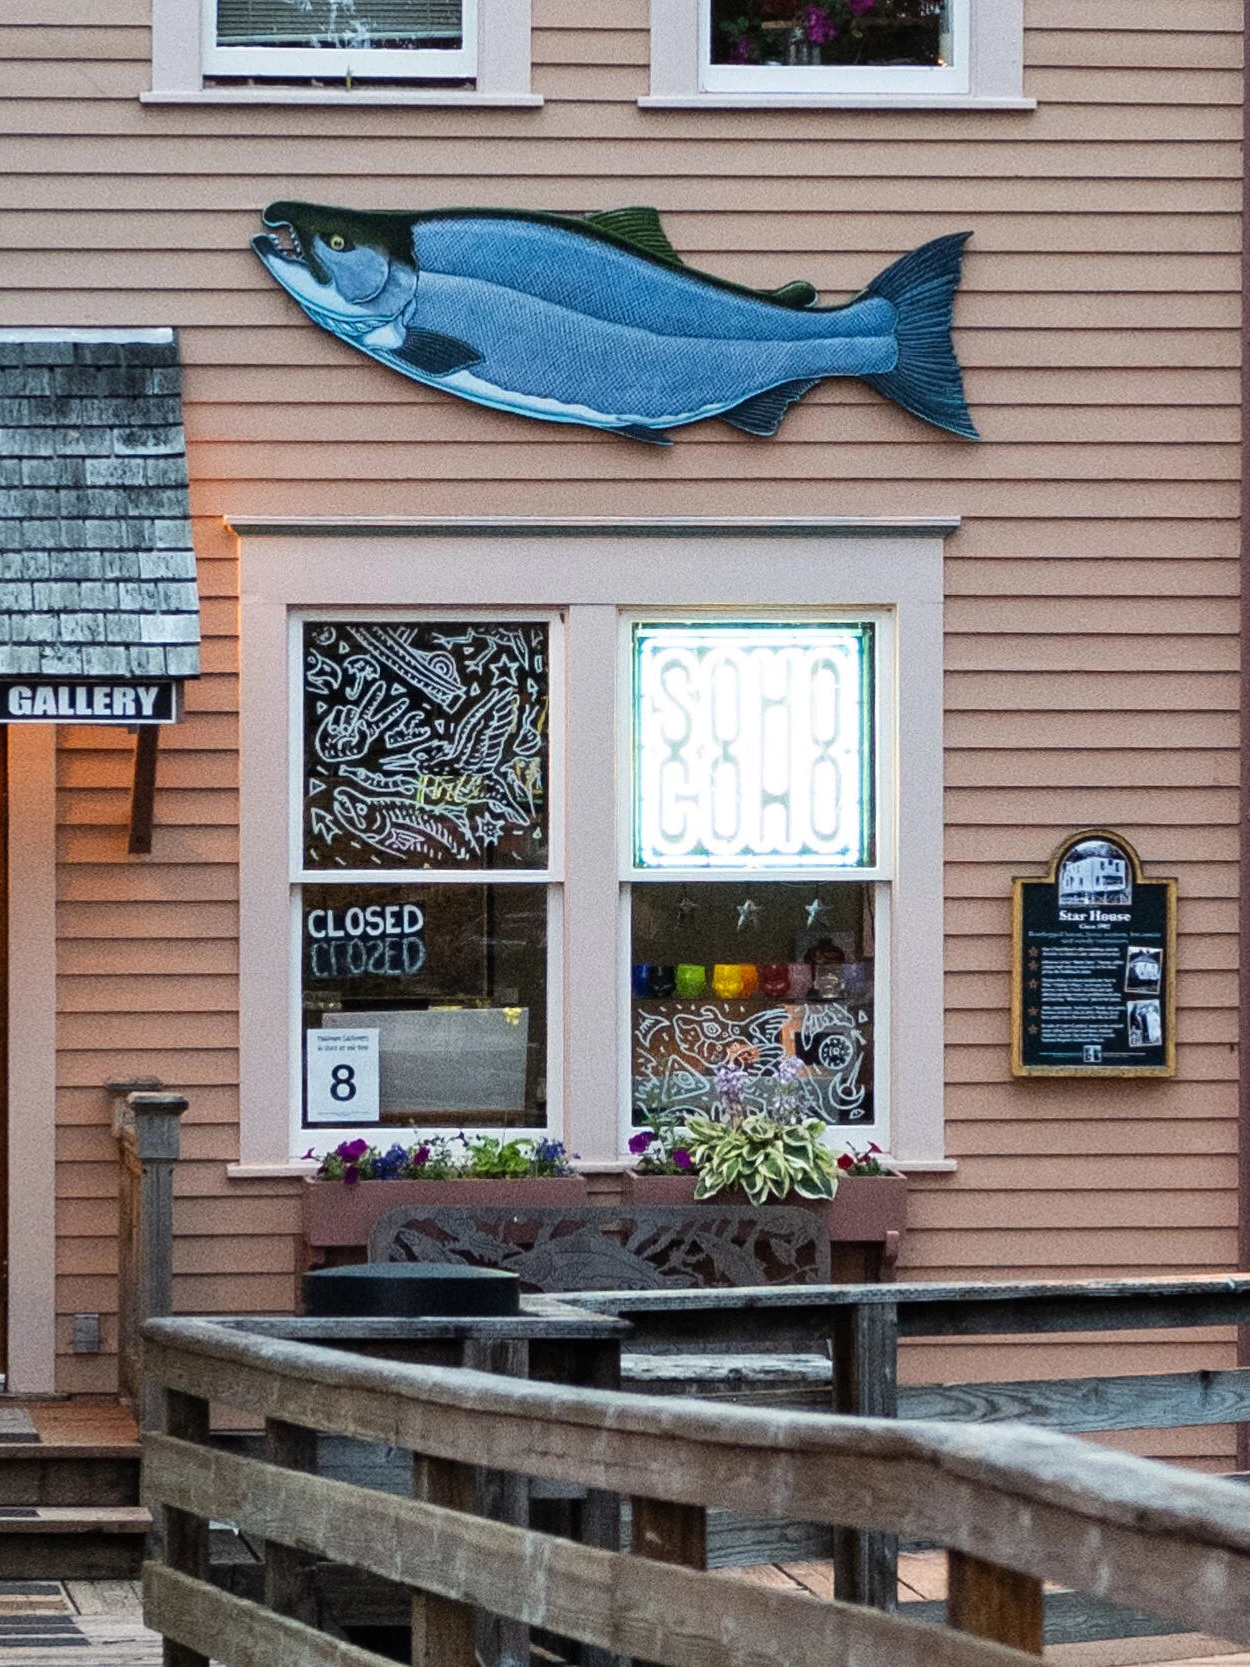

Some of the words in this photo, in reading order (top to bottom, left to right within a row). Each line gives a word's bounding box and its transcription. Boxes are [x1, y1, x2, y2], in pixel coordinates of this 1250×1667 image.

[7, 685, 160, 717] GALLERY
[649, 647, 850, 751] SOHO
[307, 904, 424, 938] CLOSED
[1058, 909, 1088, 921] Star
[1089, 910, 1132, 922] House
[330, 1063, 357, 1102] 8
